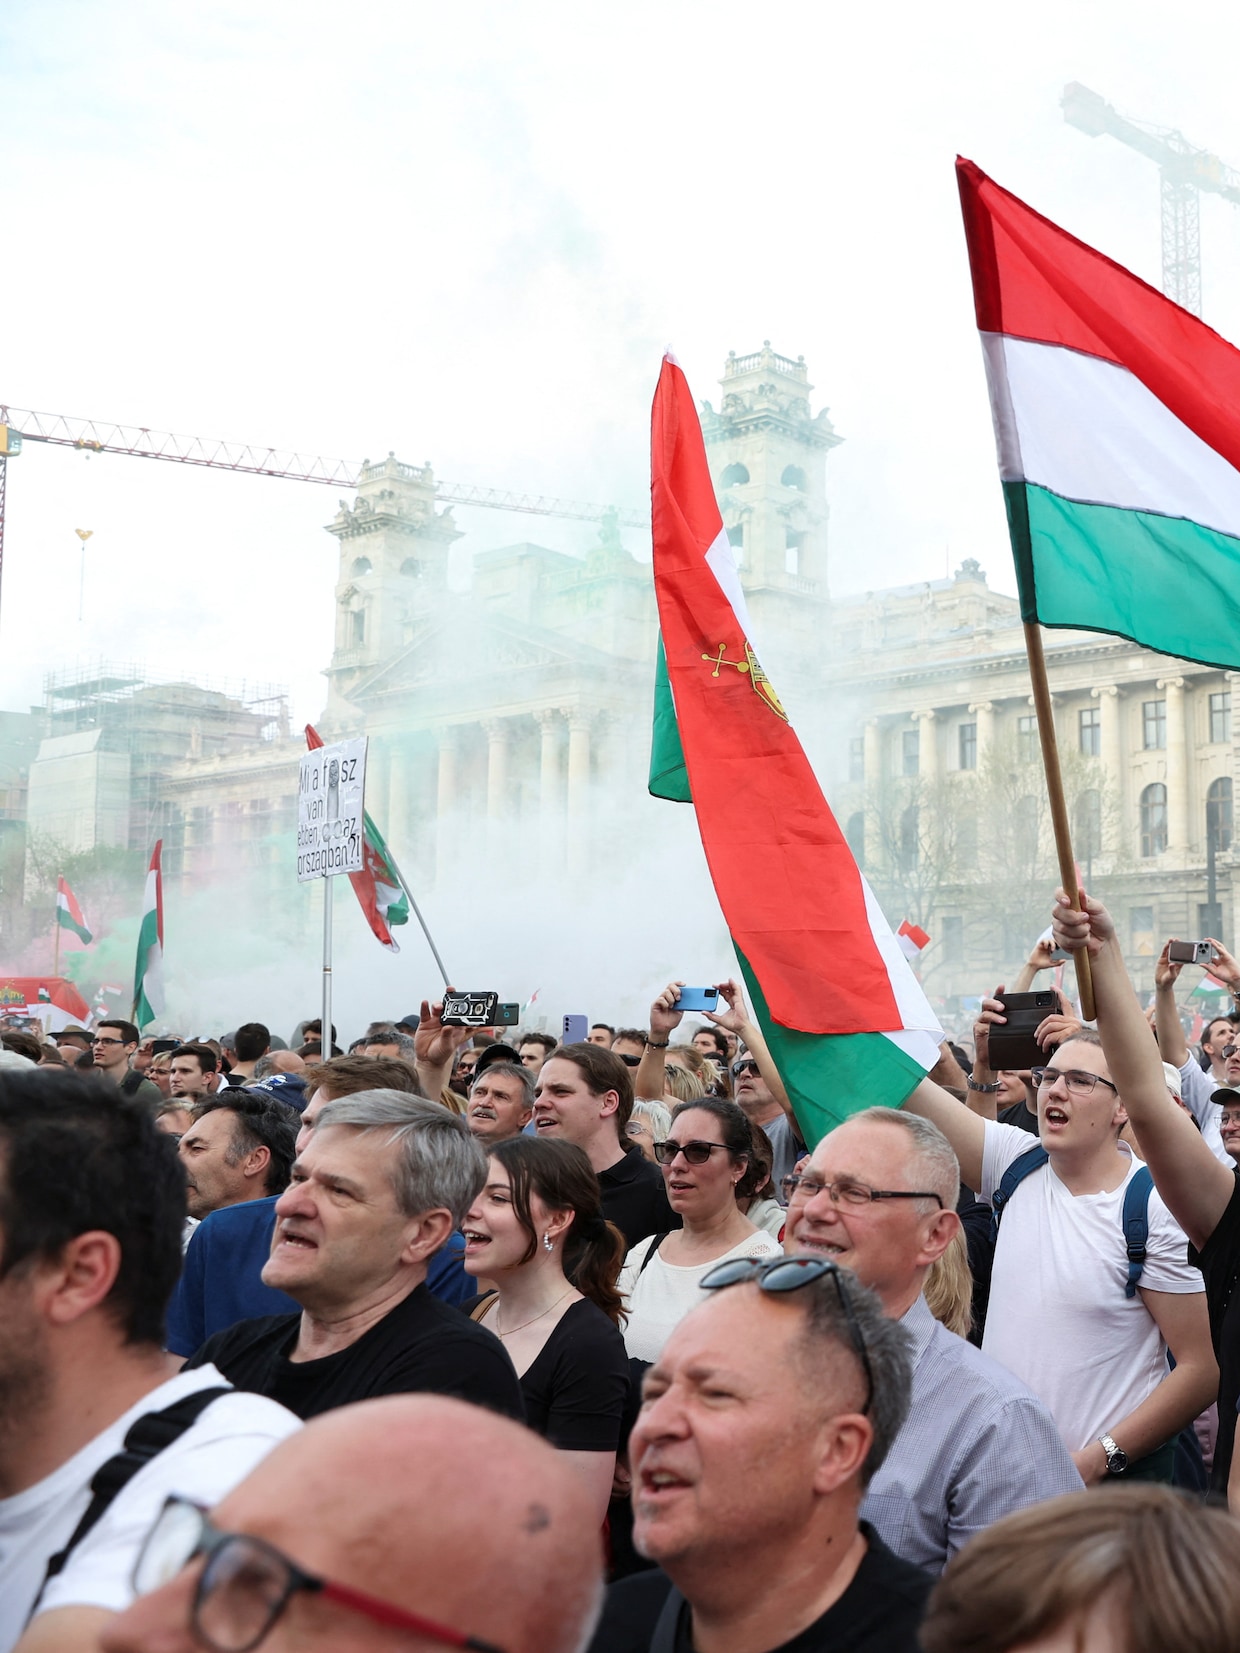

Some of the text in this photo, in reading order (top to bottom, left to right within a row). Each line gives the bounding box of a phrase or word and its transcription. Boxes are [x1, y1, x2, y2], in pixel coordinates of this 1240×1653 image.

[299, 757, 357, 795] Mi a fsz
[306, 799, 323, 821] van
[298, 817, 356, 847] ebben az
[298, 834, 360, 879] országban?!
